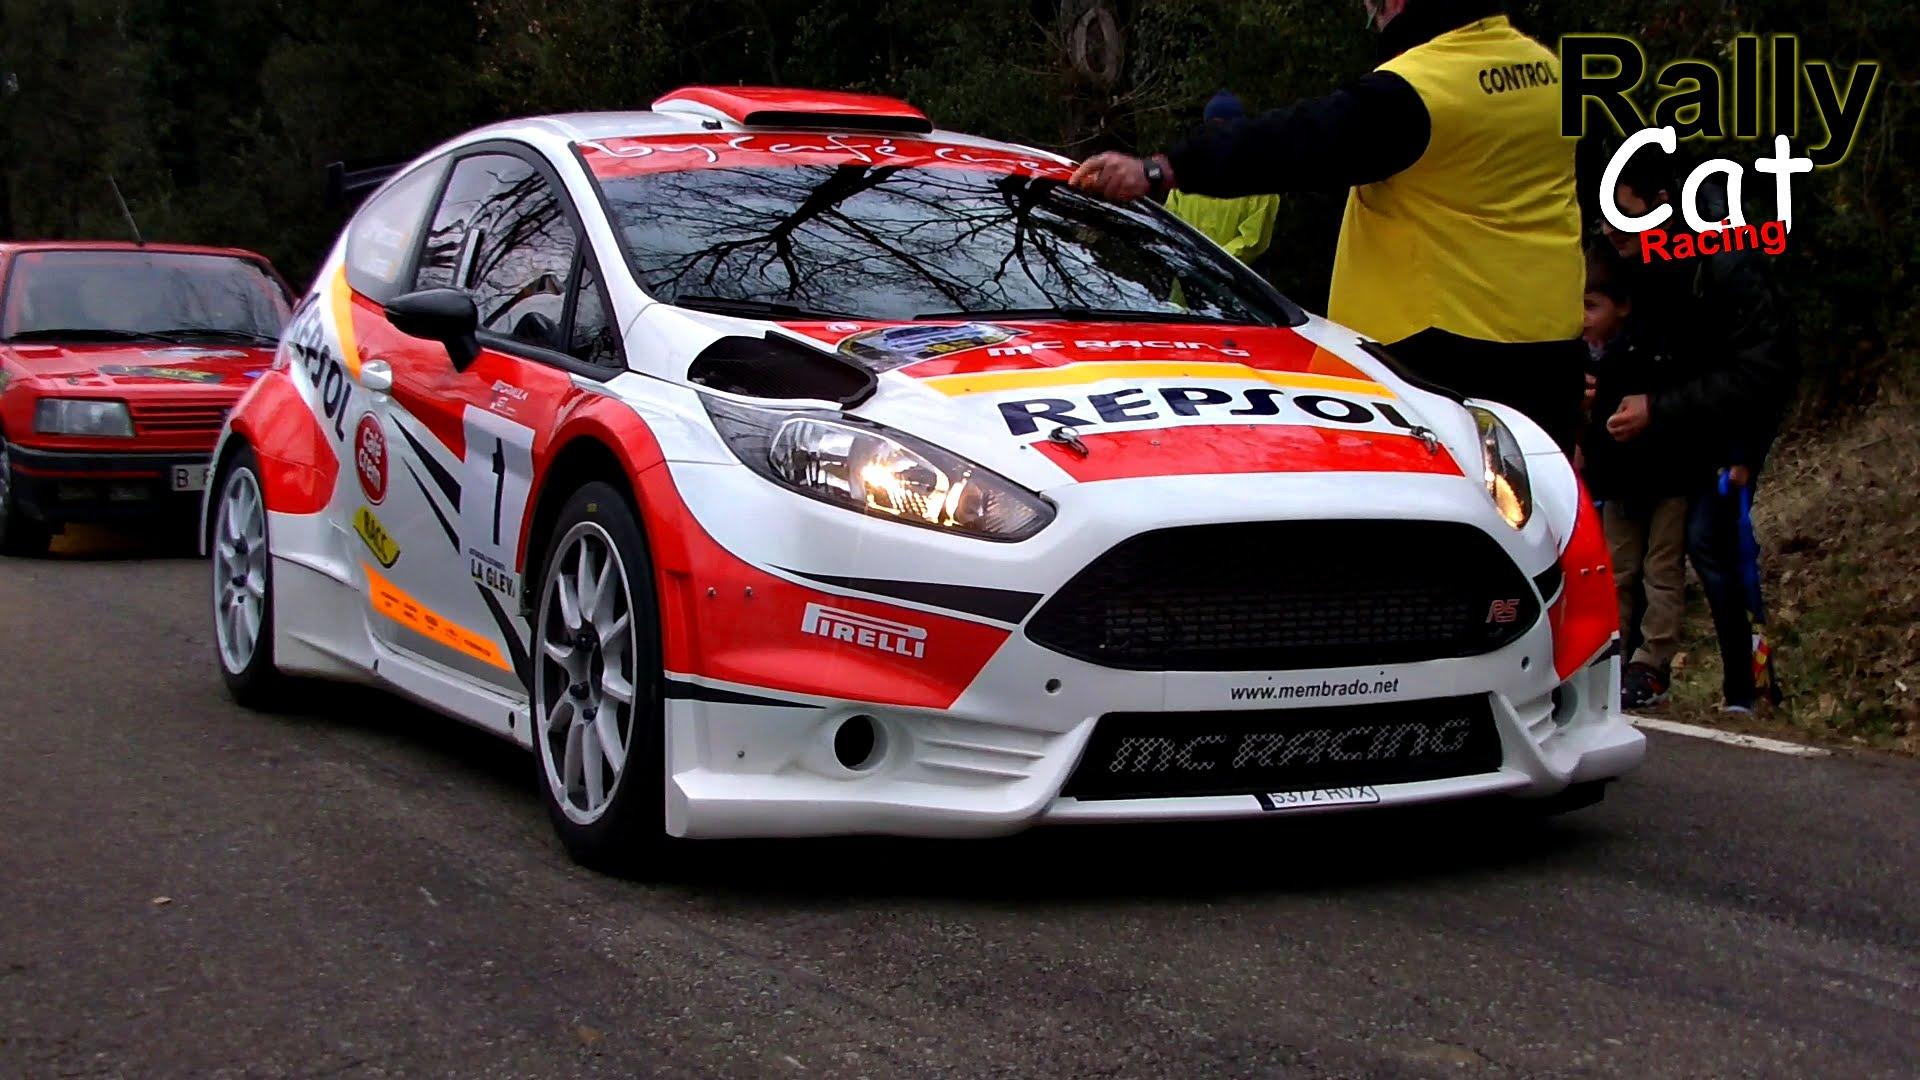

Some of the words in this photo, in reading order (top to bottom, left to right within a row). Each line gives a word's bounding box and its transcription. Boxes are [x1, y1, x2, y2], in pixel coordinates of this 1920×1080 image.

[1479, 61, 1558, 95] CONTROL
[288, 293, 352, 442] EPSOL
[997, 387, 1428, 436] REPSOL
[176, 467, 190, 488] B
[492, 437, 506, 546] 1
[801, 602, 928, 658] PIRELLI
[1485, 598, 1520, 623] RS
[1231, 678, 1399, 700] www.membrado.net
